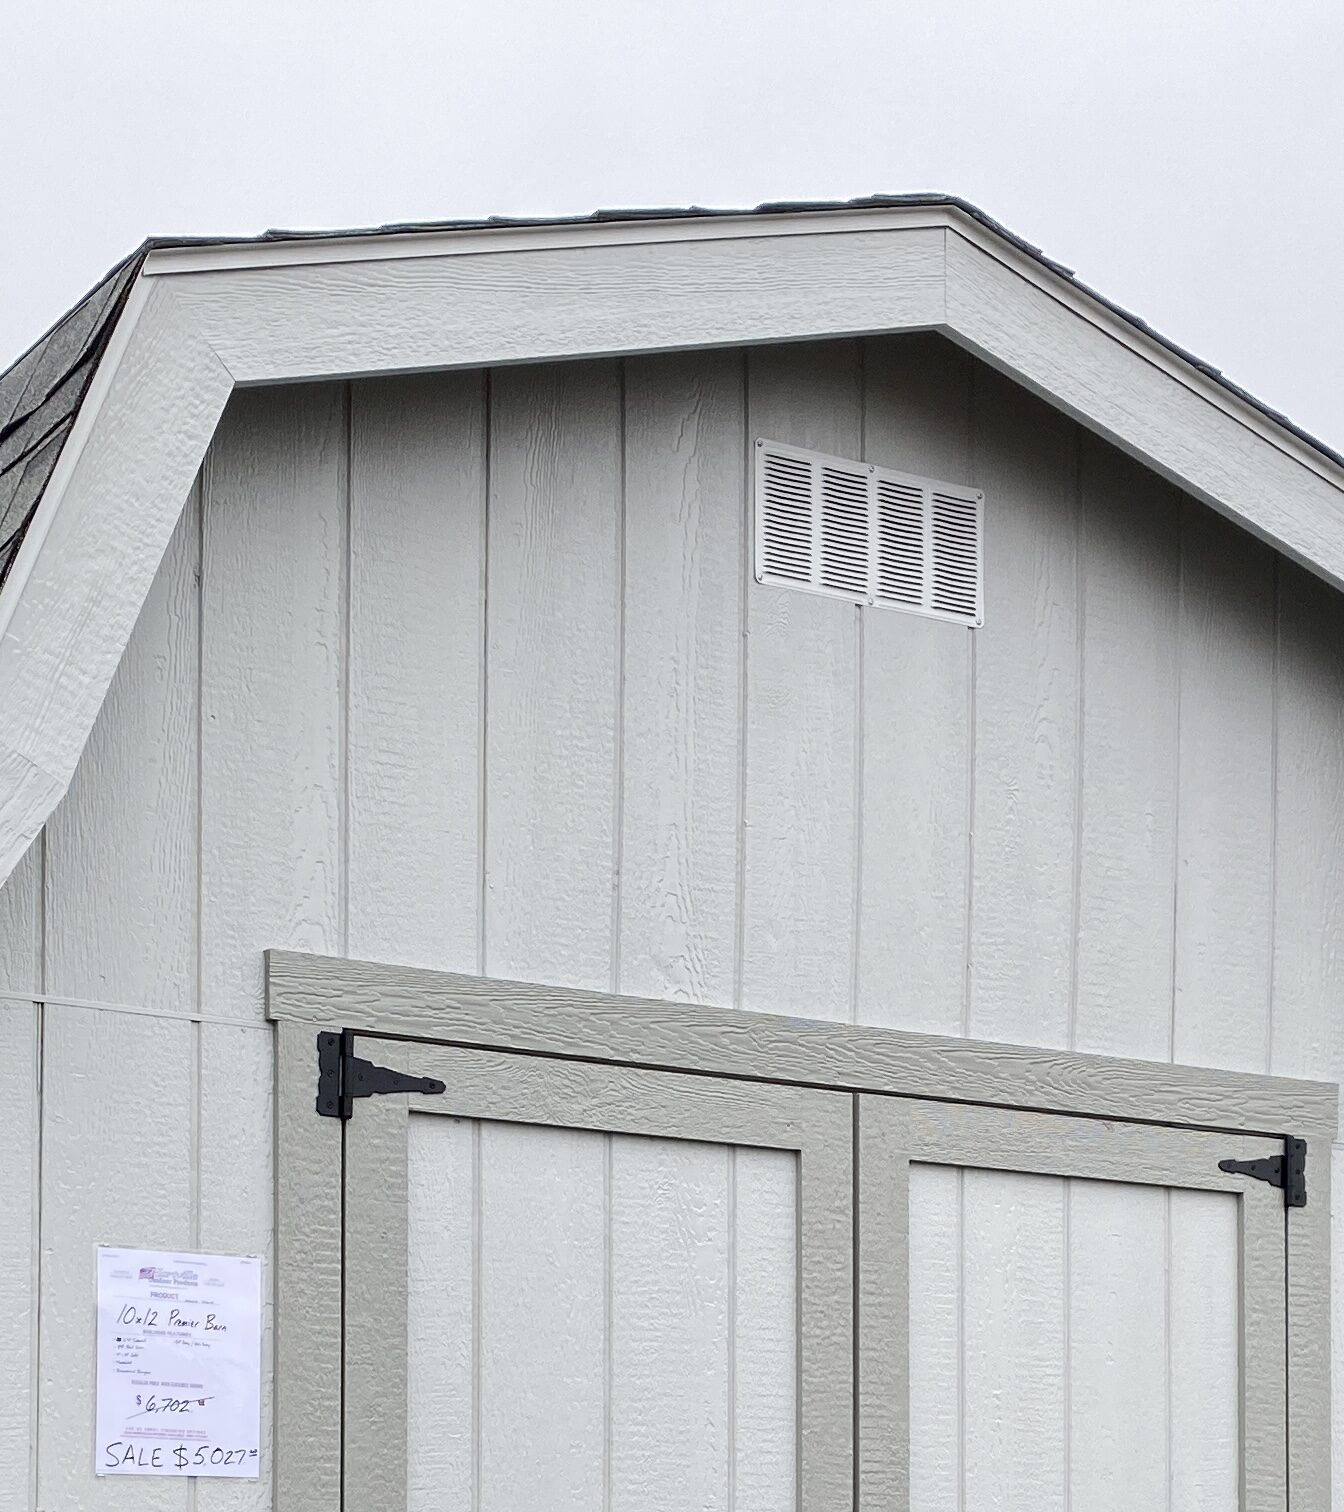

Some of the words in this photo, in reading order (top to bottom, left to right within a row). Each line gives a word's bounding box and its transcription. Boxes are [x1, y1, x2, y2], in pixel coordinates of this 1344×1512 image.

[116, 1303, 158, 1326] 10x12
[168, 1309, 199, 1328] Premier
[205, 1314, 227, 1332] Barn
[105, 1442, 164, 1467] SALE
